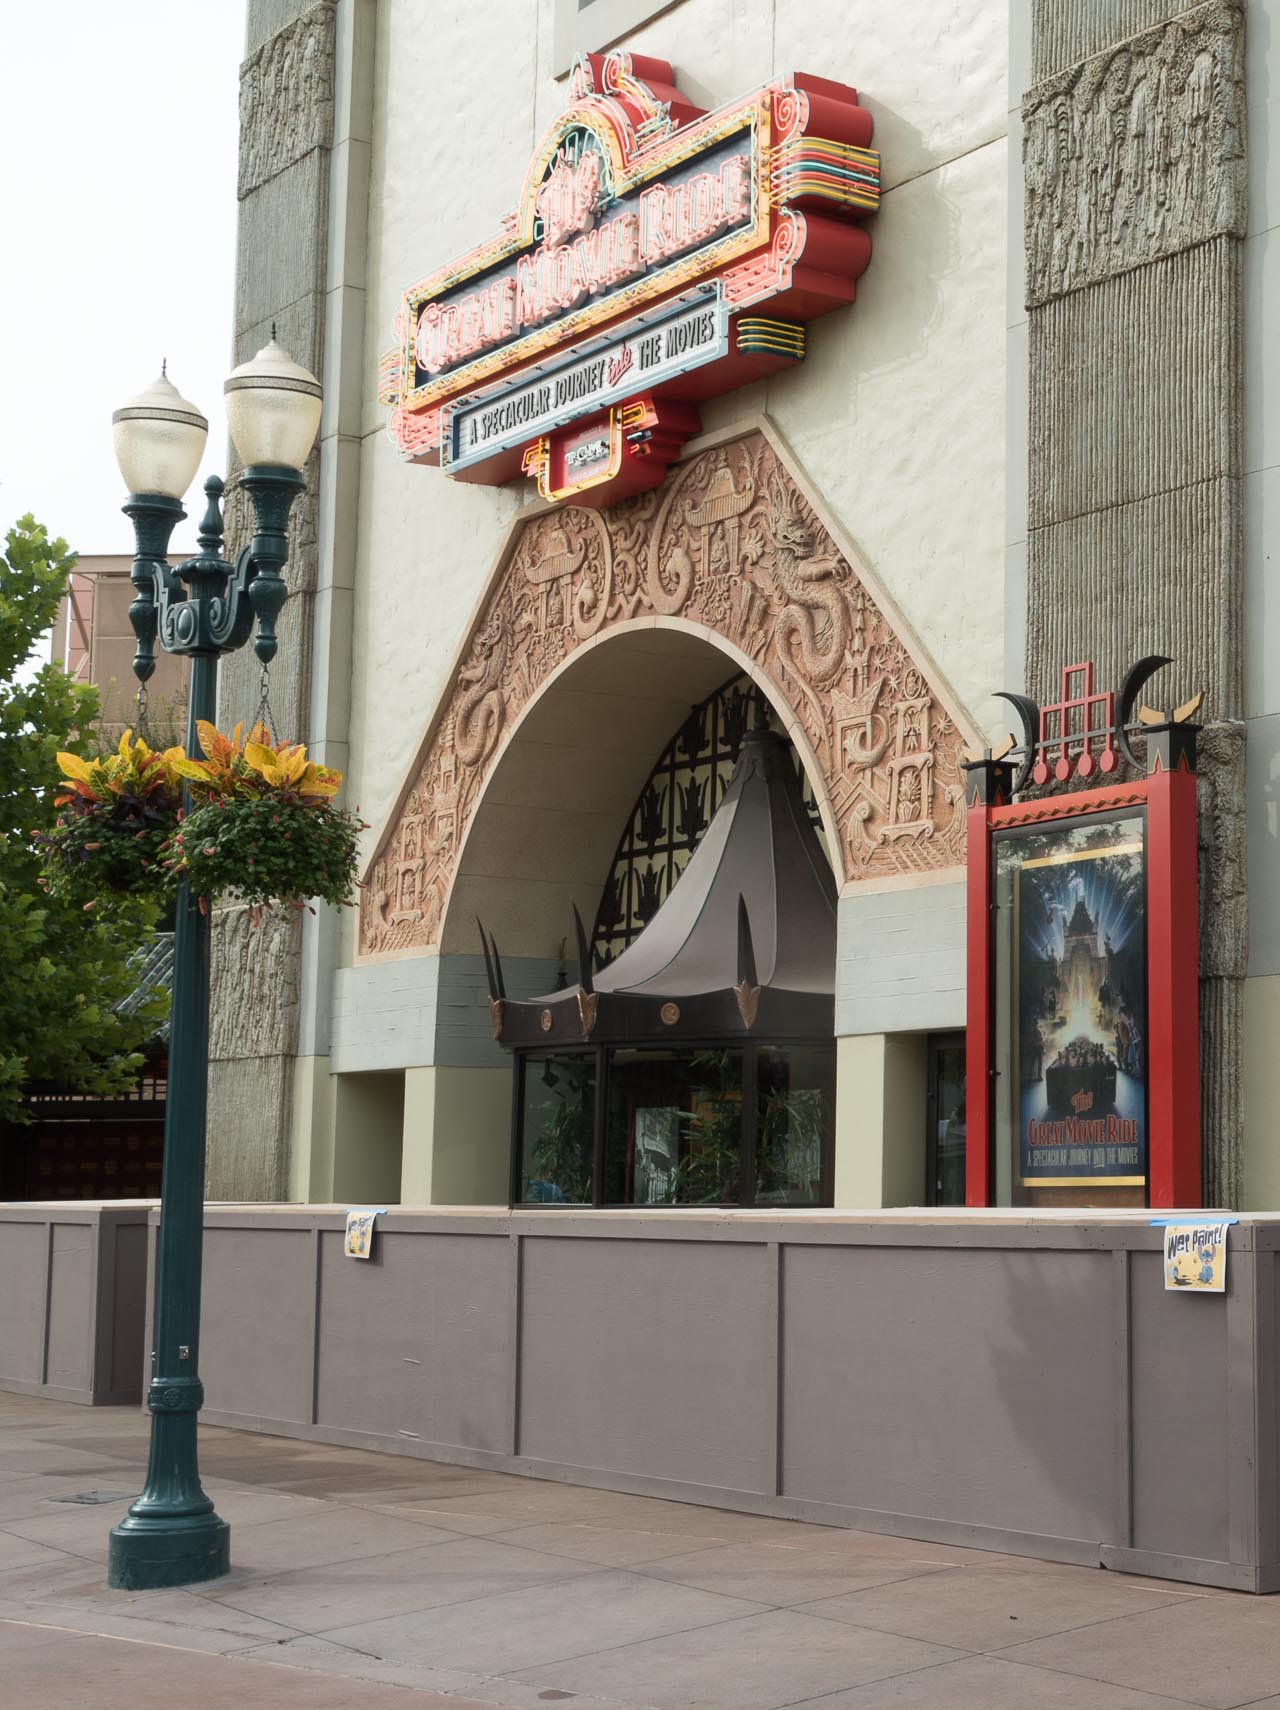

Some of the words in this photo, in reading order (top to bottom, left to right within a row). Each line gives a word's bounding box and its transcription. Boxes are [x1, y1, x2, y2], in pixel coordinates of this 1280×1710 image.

[415, 276, 520, 373] GREAT
[516, 211, 646, 326] MOVIE
[639, 155, 752, 264] RIDE
[470, 418, 477, 445] A
[481, 386, 550, 439] SPECTACULAR
[551, 359, 605, 409] JOURNEY
[607, 341, 634, 387] into
[637, 334, 661, 370] THE
[665, 311, 714, 360] MOVIES
[1027, 1117, 1065, 1147] GREAT
[1065, 1116, 1105, 1145] MOVIE
[1106, 1114, 1138, 1144] RIDE
